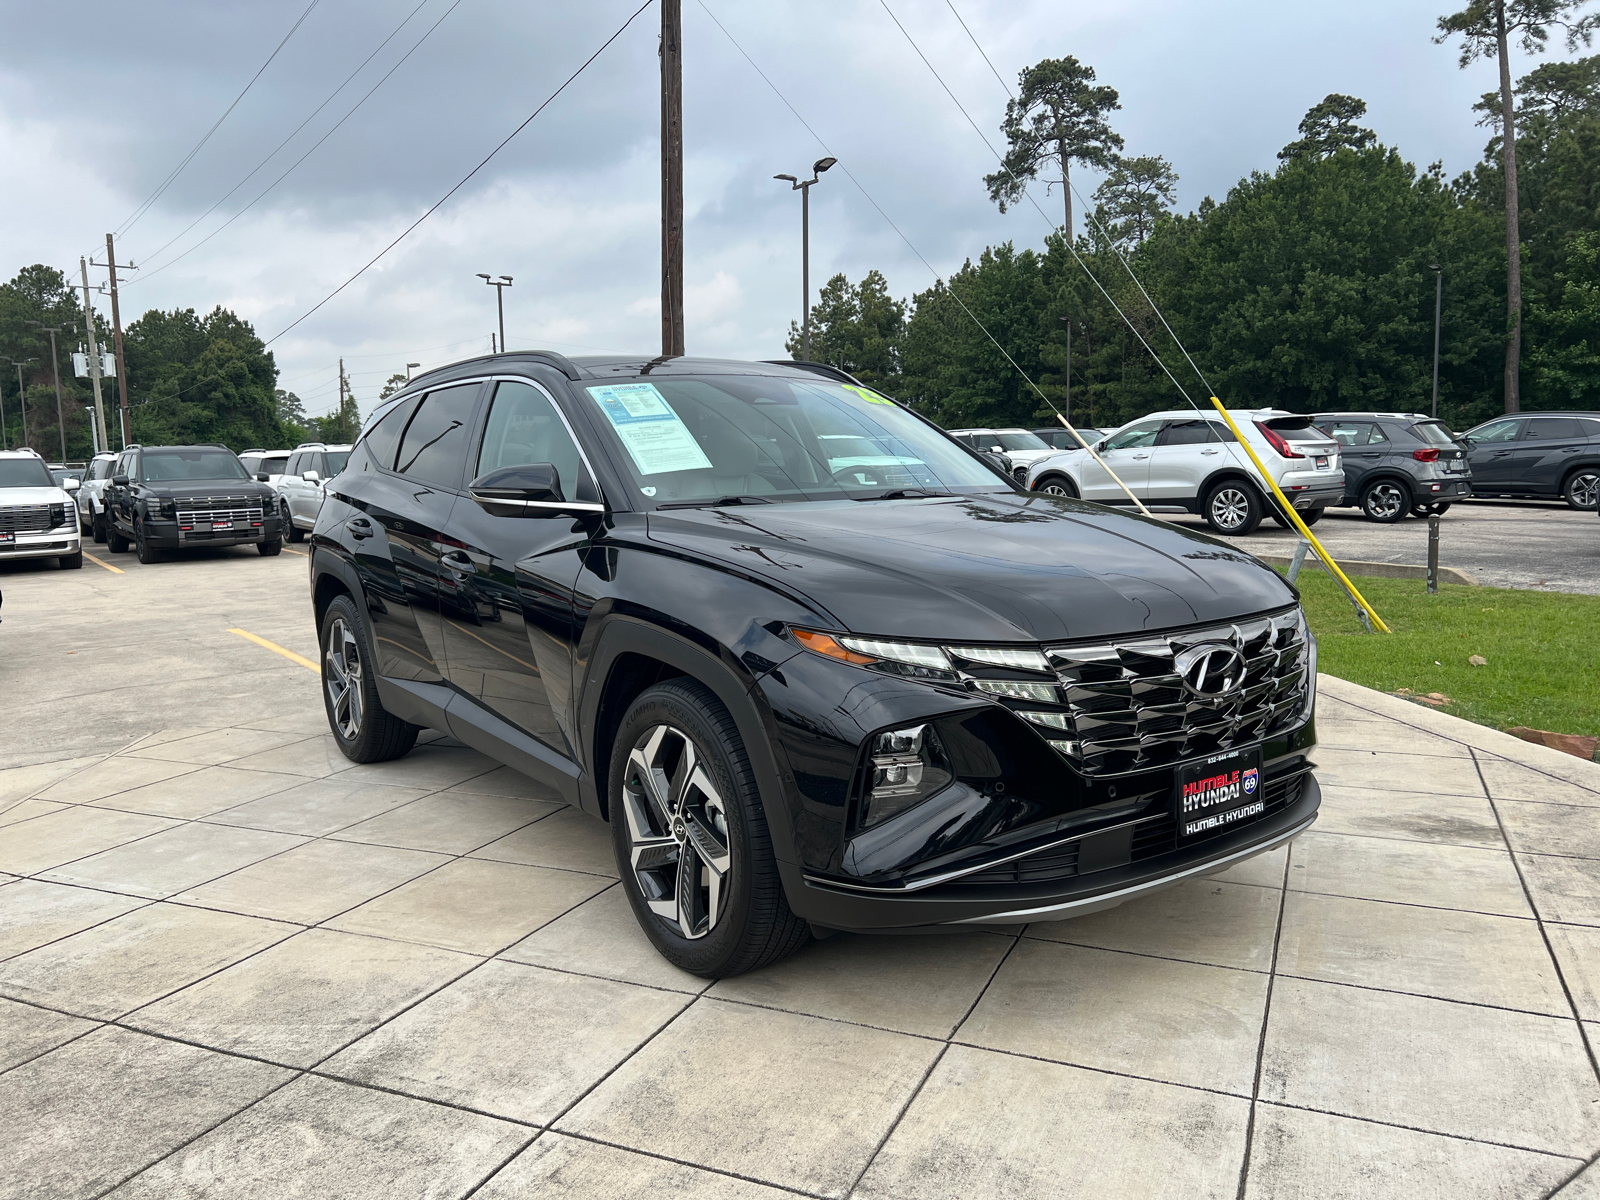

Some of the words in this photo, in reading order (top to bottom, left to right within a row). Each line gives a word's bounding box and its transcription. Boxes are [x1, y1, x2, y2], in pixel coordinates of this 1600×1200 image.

[626, 701, 656, 729] KUMHO
[1183, 770, 1240, 797] HUMBLE
[1183, 782, 1240, 812] HYUNDAI
[1244, 777, 1256, 790] 69
[1186, 815, 1225, 834] HUMBLE
[1226, 802, 1264, 822] HYUNDAI
